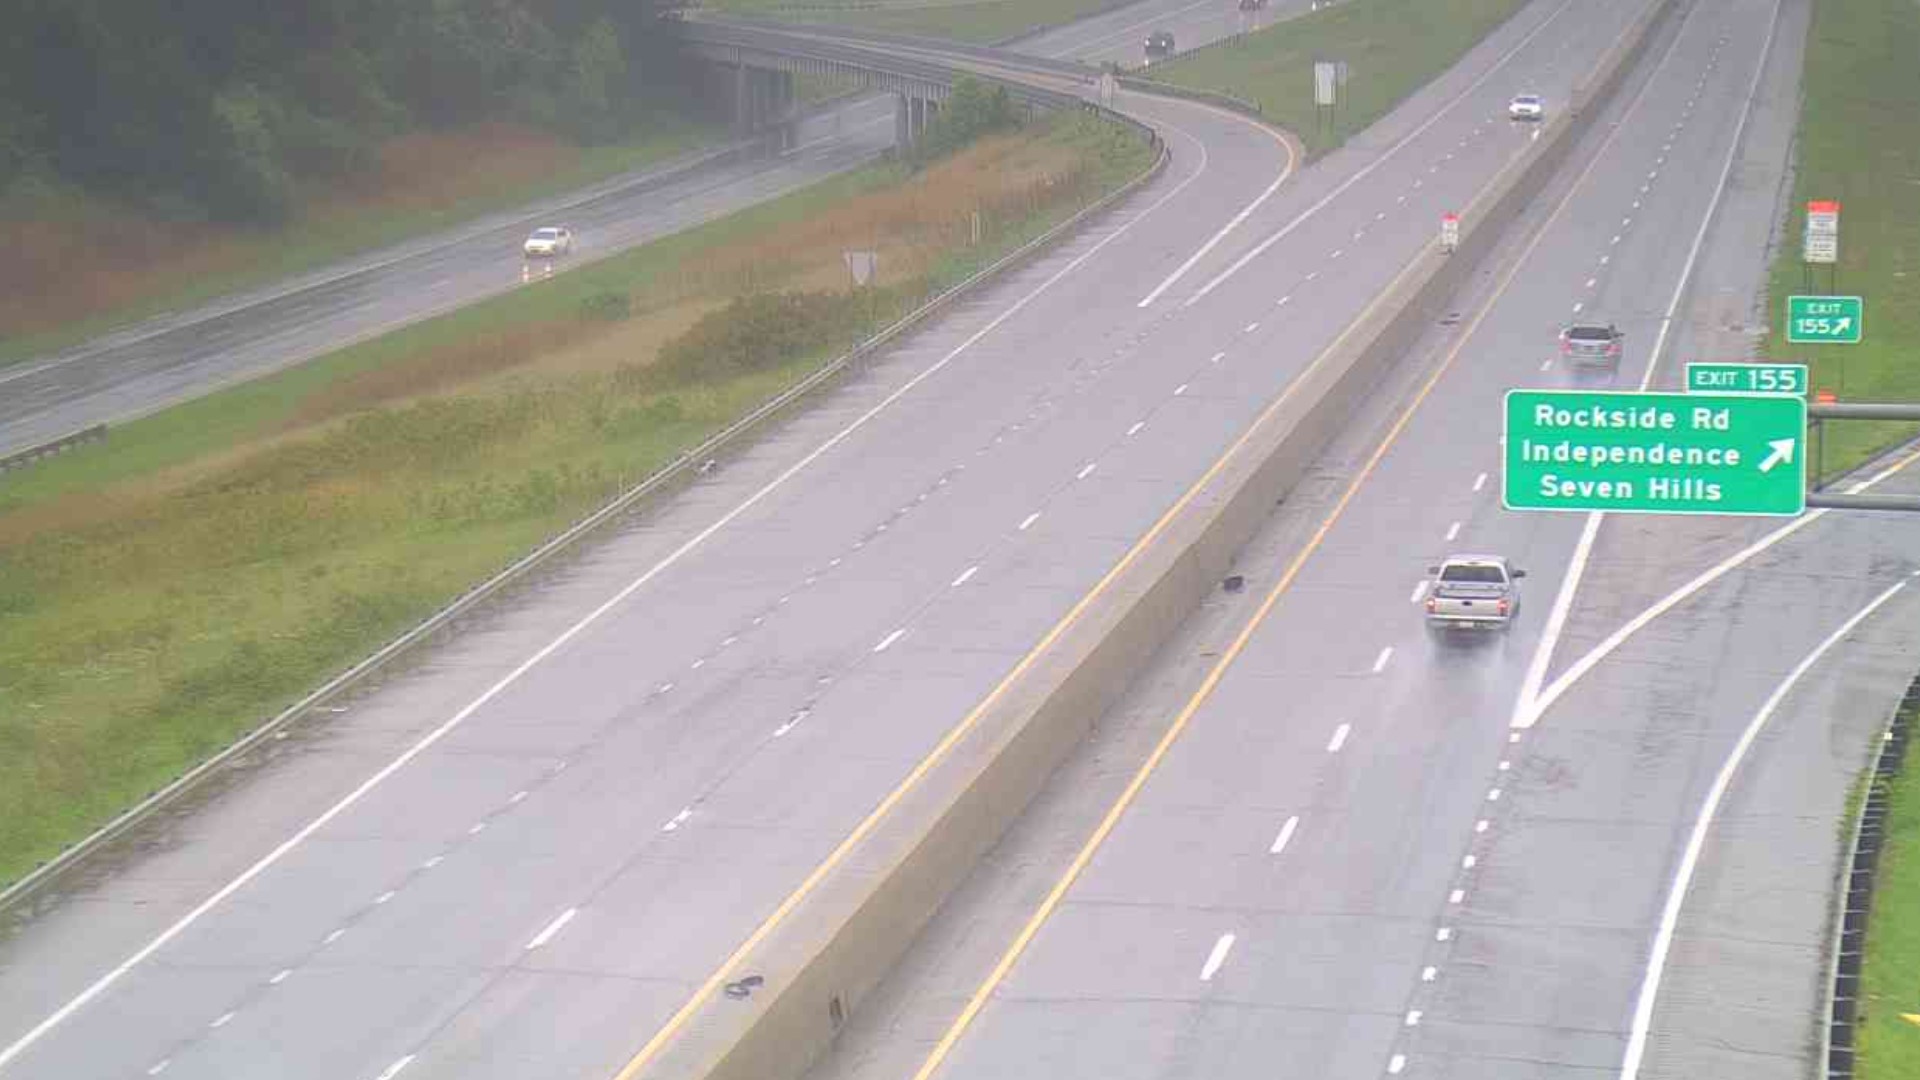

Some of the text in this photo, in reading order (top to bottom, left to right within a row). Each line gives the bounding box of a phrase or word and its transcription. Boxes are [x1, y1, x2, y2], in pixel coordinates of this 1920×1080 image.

[1797, 319, 1830, 334] 155
[1695, 369, 1797, 390] EXIT 155
[1535, 404, 1730, 430] Rockside Rd
[1523, 440, 1740, 468] Independence
[1541, 474, 1721, 501] Seven Hills
